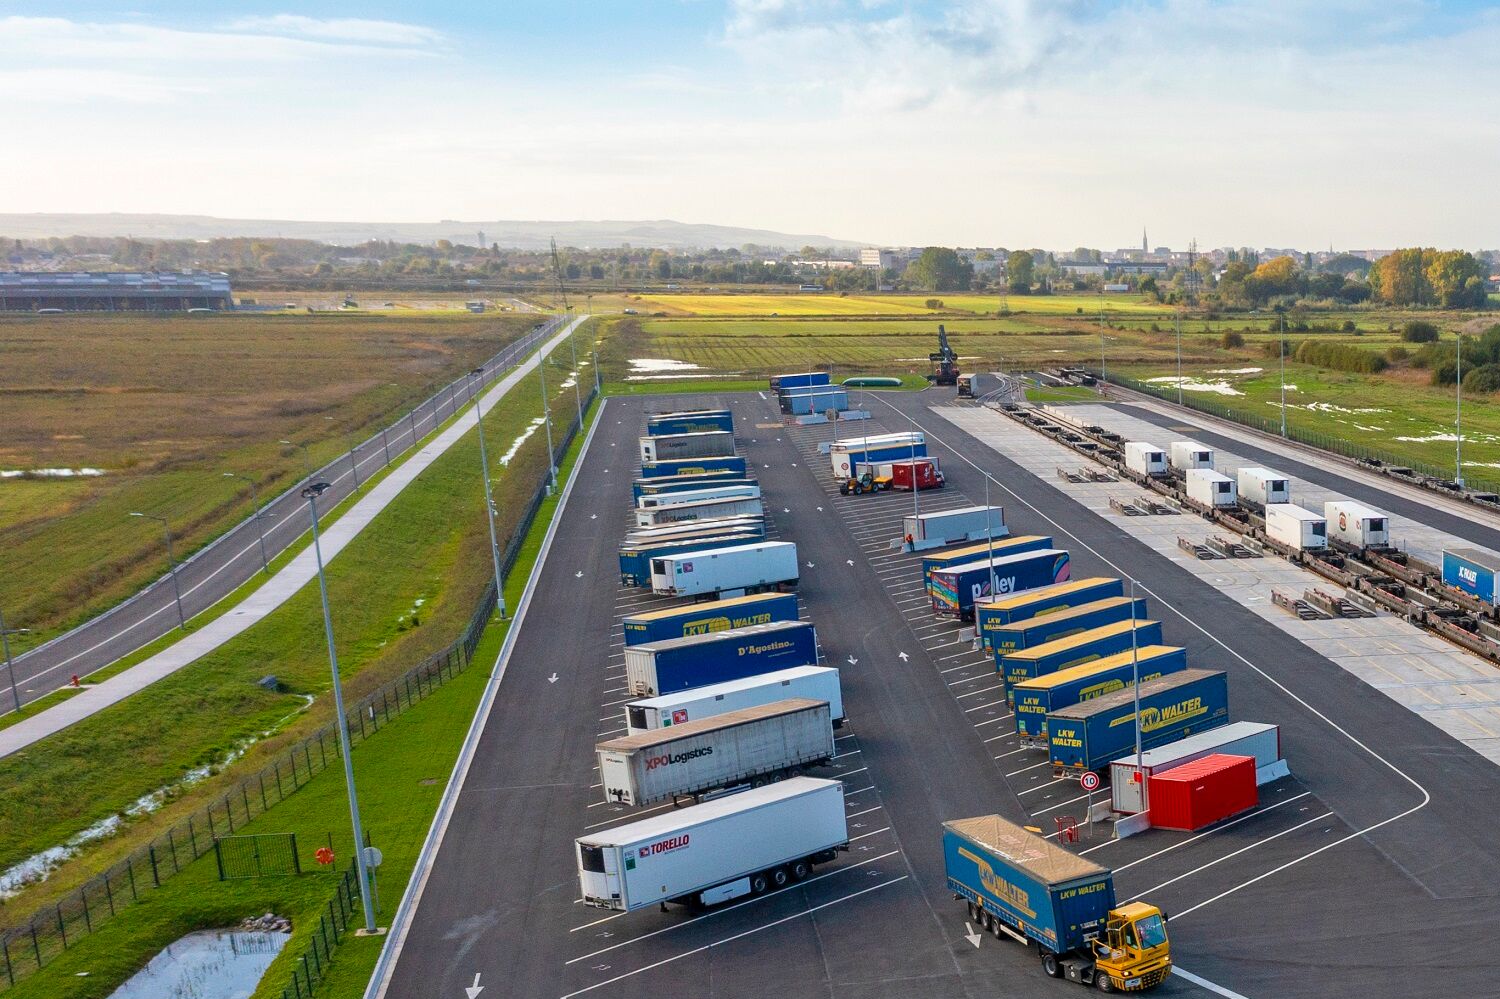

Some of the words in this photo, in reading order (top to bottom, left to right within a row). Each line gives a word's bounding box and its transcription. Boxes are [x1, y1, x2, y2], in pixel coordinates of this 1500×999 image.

[733, 613, 771, 628] WALTER
[738, 641, 790, 656] D'Agostino
[1023, 697, 1040, 705] LKW
[1018, 705, 1047, 714] WALTER
[1161, 697, 1202, 721] WALTER
[1057, 729, 1076, 738] LKW
[1052, 737, 1083, 748] WALTER
[1085, 777, 1095, 785] 10
[651, 834, 690, 855] TORELLO
[994, 874, 1029, 908] WALTER
[1060, 889, 1077, 900] LKW
[1078, 883, 1106, 896] WALTER
